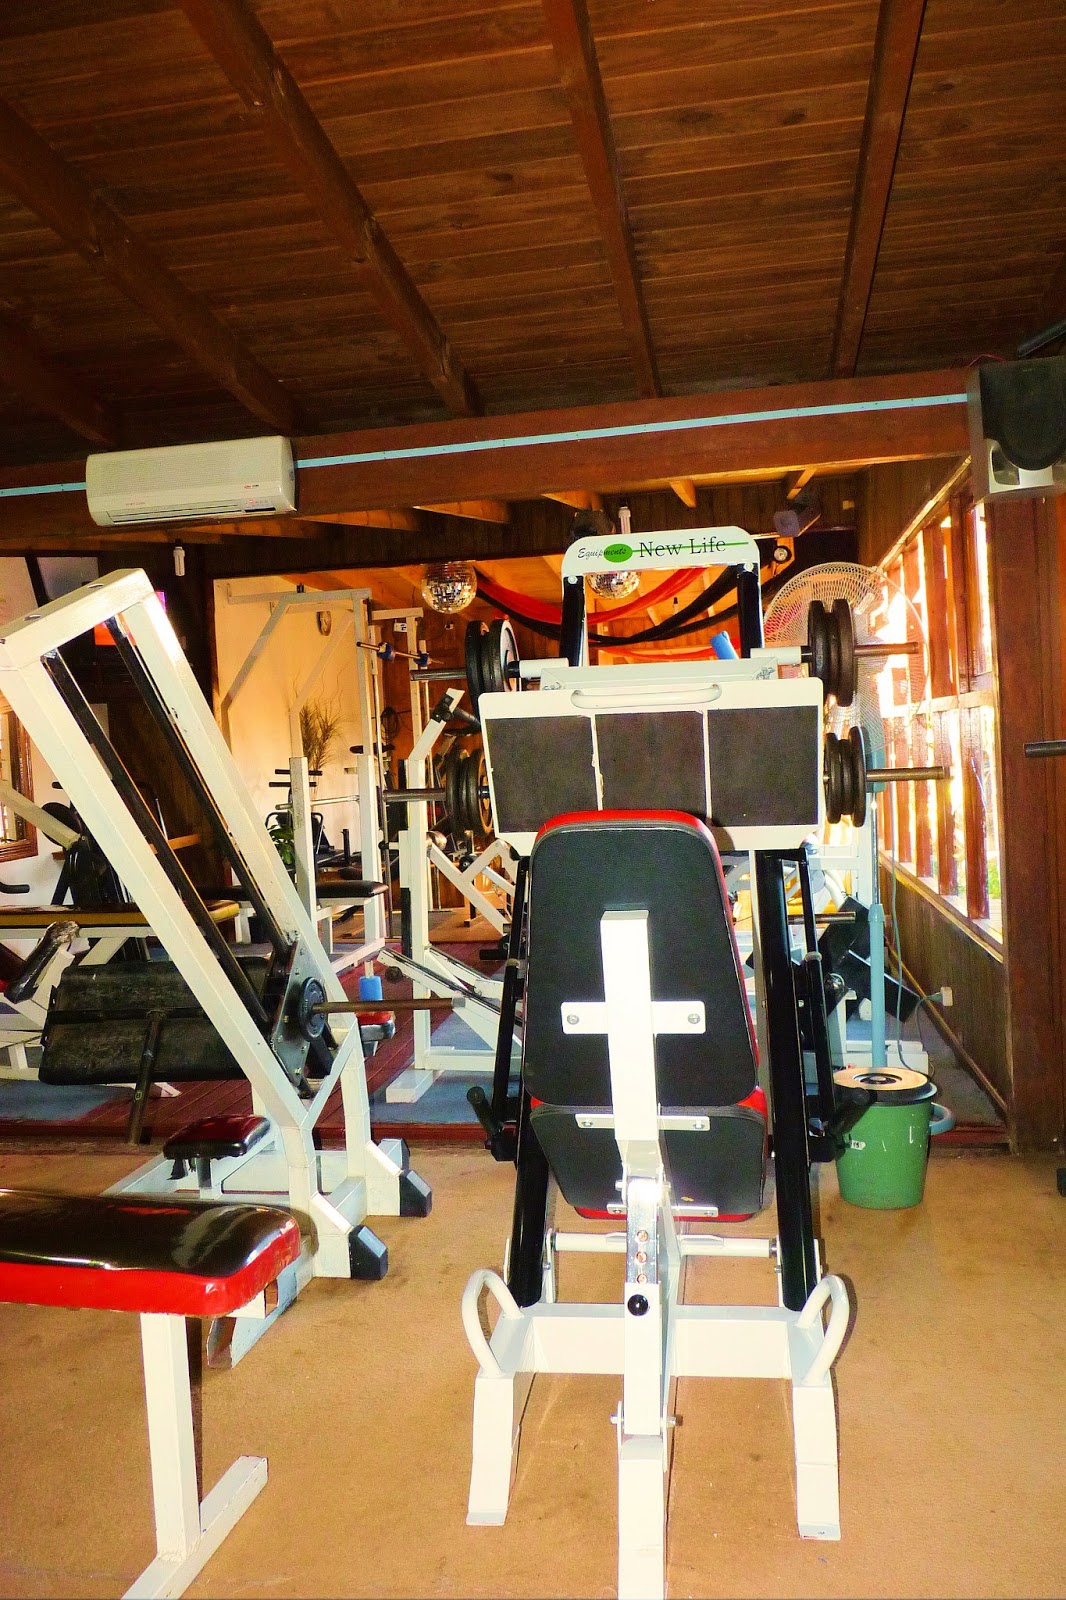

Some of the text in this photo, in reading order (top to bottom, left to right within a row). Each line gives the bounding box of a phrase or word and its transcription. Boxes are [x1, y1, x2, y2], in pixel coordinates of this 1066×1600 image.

[577, 536, 727, 560] Equipments New Life
